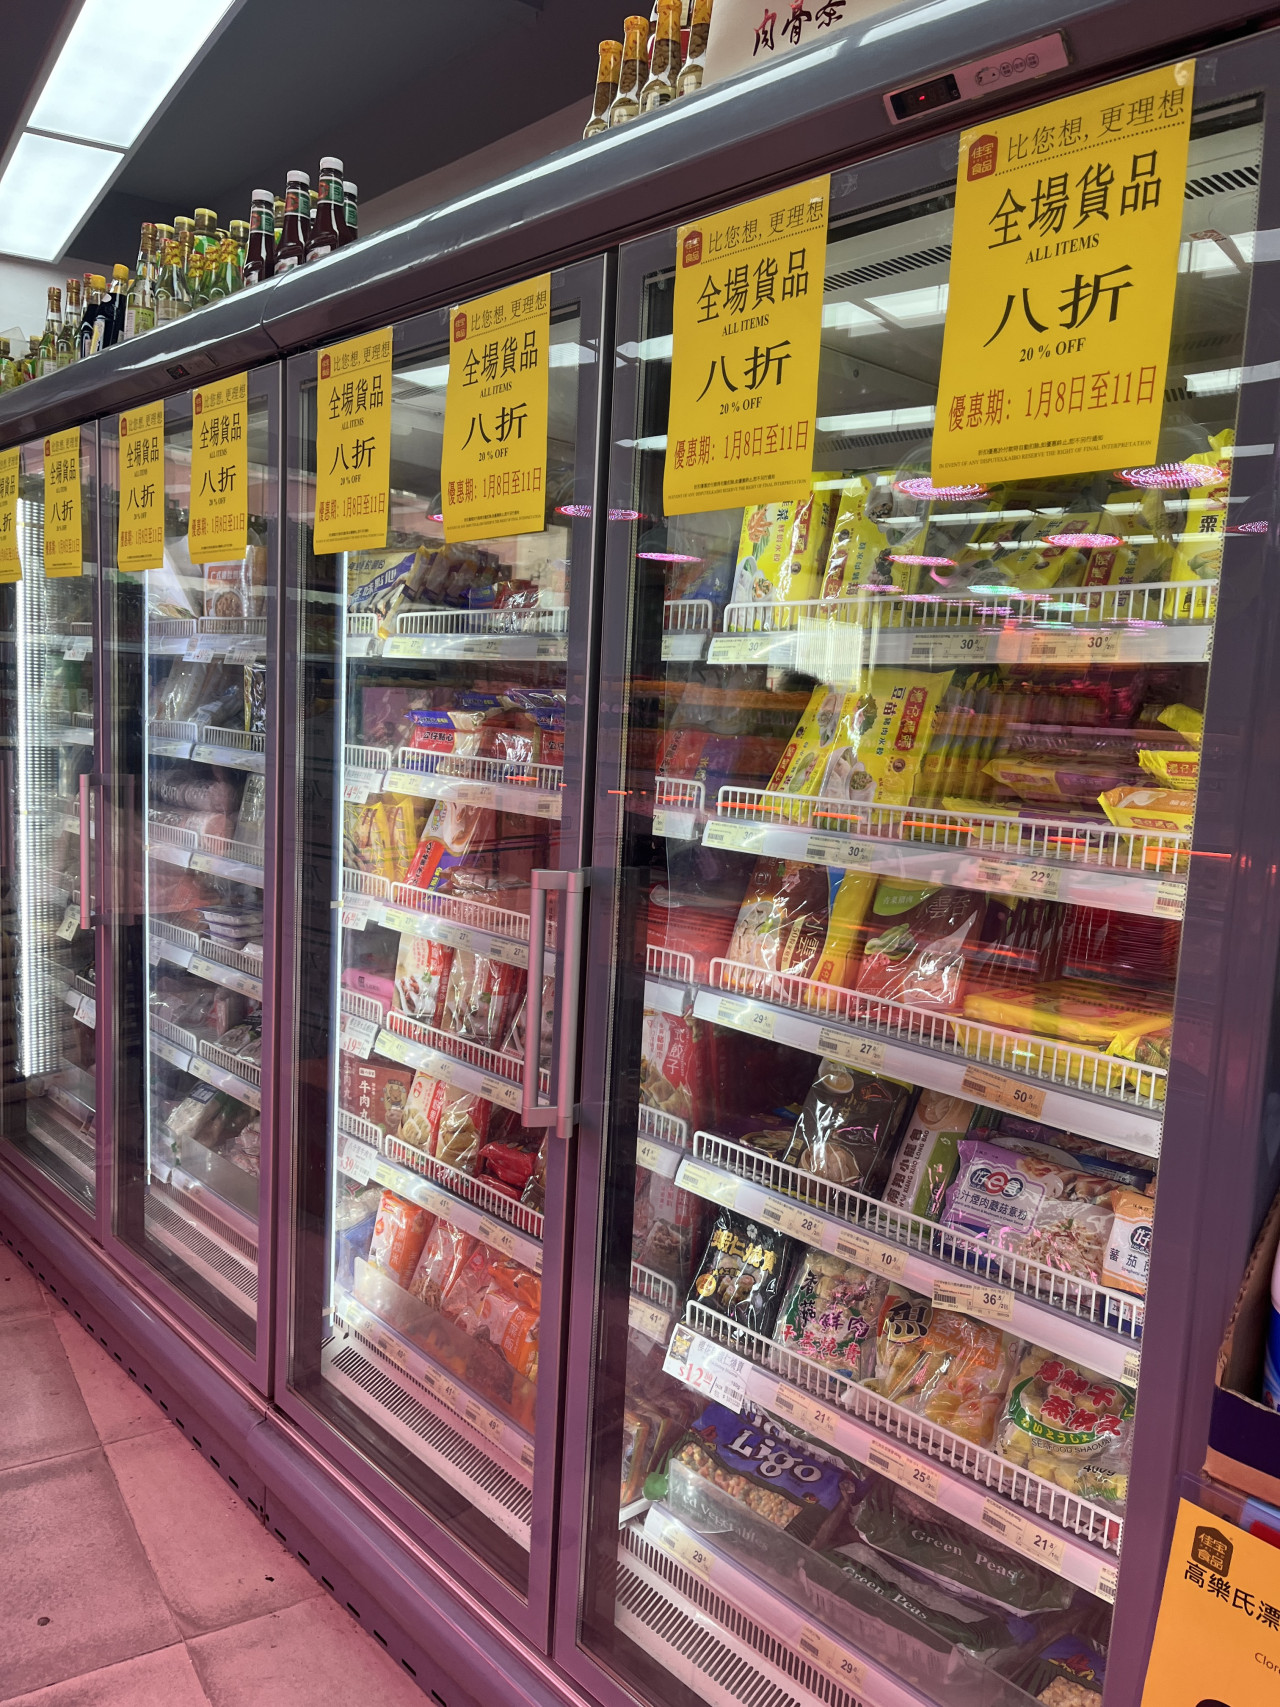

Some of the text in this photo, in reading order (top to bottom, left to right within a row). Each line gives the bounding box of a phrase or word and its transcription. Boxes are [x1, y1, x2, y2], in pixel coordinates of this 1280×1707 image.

[988, 150, 1162, 250] 全場貨品
[1025, 233, 1100, 264] ALL ITEMS
[697, 248, 809, 324] 全場貨品
[983, 264, 1134, 348] 八折
[722, 314, 769, 337] ALL ITEMS
[462, 330, 538, 387] 全場貨品
[1055, 337, 1087, 356] OFF
[480, 381, 512, 398] ALL ITEMS
[696, 340, 792, 402] 八折
[329, 374, 383, 420] 全場貨品
[742, 397, 762, 411] OFF
[1025, 365, 1157, 421] 1月8日至11日
[200, 412, 241, 449] 全場貨品
[461, 402, 528, 451] 八折
[723, 420, 809, 463] 1月8日至11日
[127, 437, 159, 469] 全場貨品
[329, 436, 376, 475] 八折
[495, 447, 509, 458] OFF
[50, 458, 76, 485] 全場貨品
[199, 465, 236, 496] 八折
[482, 467, 541, 499] 1月8日至11日
[50, 500, 73, 523] 八折
[127, 483, 155, 511] 八折
[800, 1270, 817, 1327] 香菇
[729, 1429, 821, 1482] Ligo
[1032, 1438, 1073, 1454] SEAFOOD
[911, 1529, 1018, 1580] Green Peas
[1197, 1548, 1224, 1571] 食品
[842, 1566, 928, 1621] Green Peas
[1184, 1560, 1280, 1632] 高樂氏漂
[1254, 1651, 1280, 1675] Clor
